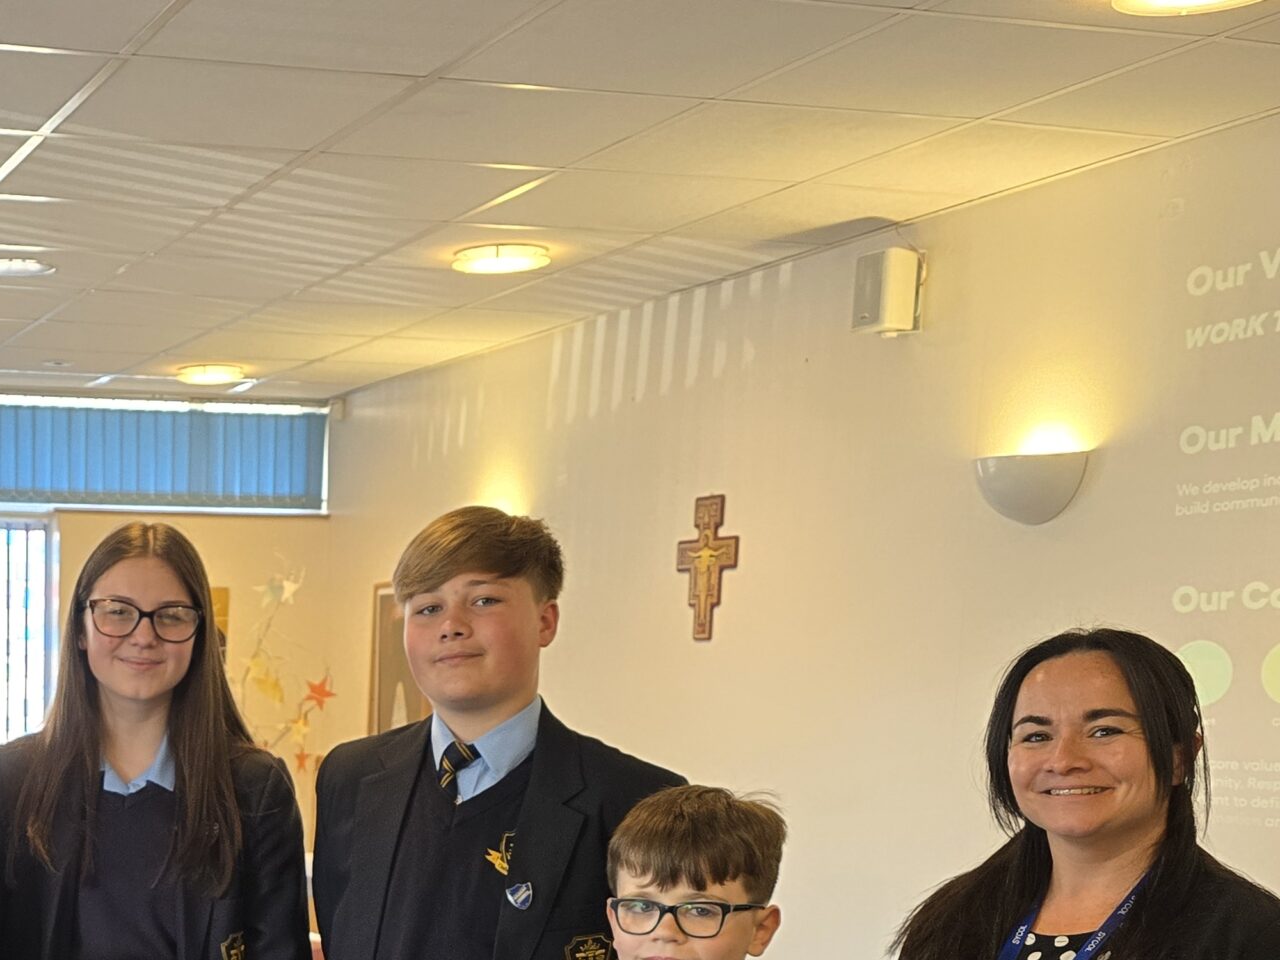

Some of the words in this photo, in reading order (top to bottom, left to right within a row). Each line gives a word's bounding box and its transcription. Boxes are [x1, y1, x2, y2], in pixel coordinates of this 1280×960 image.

[1186, 264, 1253, 296] Our
[1184, 312, 1268, 350] WORK
[1179, 425, 1243, 454] Our
[1176, 483, 1200, 496] We
[1202, 476, 1260, 494] develop
[1175, 500, 1210, 516] build
[1172, 585, 1235, 614] Our
[1012, 924, 1028, 945] SYCOL
[1084, 931, 1106, 952] SYCOL
